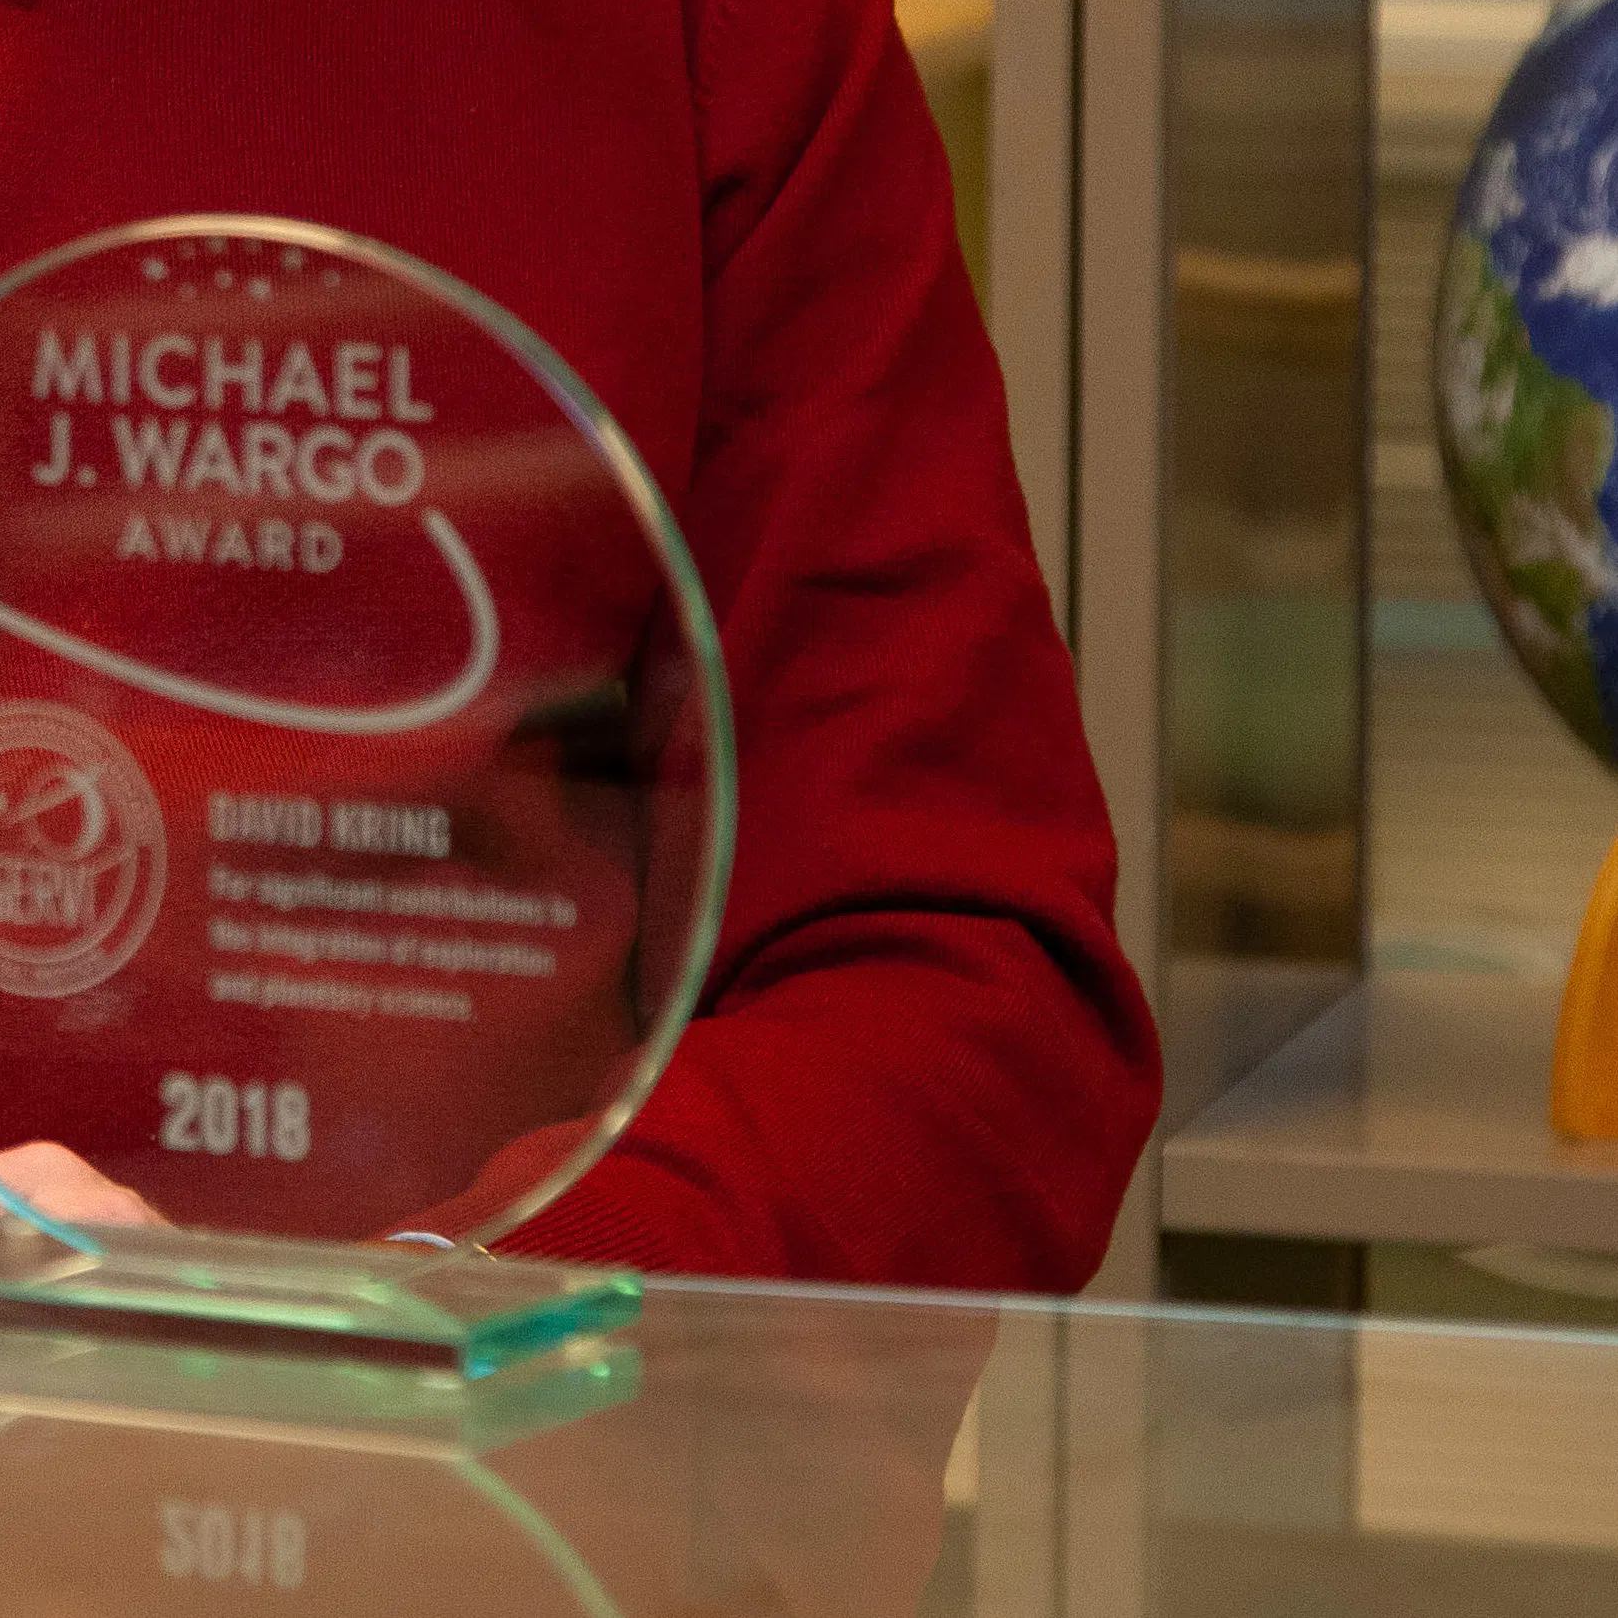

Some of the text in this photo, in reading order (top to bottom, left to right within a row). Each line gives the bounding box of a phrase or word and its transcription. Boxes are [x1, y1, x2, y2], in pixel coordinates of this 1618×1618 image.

[32, 329, 434, 423] MICHAEL
[32, 410, 425, 508] J. WARGO
[116, 514, 345, 574] AWARD
[208, 791, 450, 859] DAVID KRING
[160, 1072, 311, 1162] 2018
